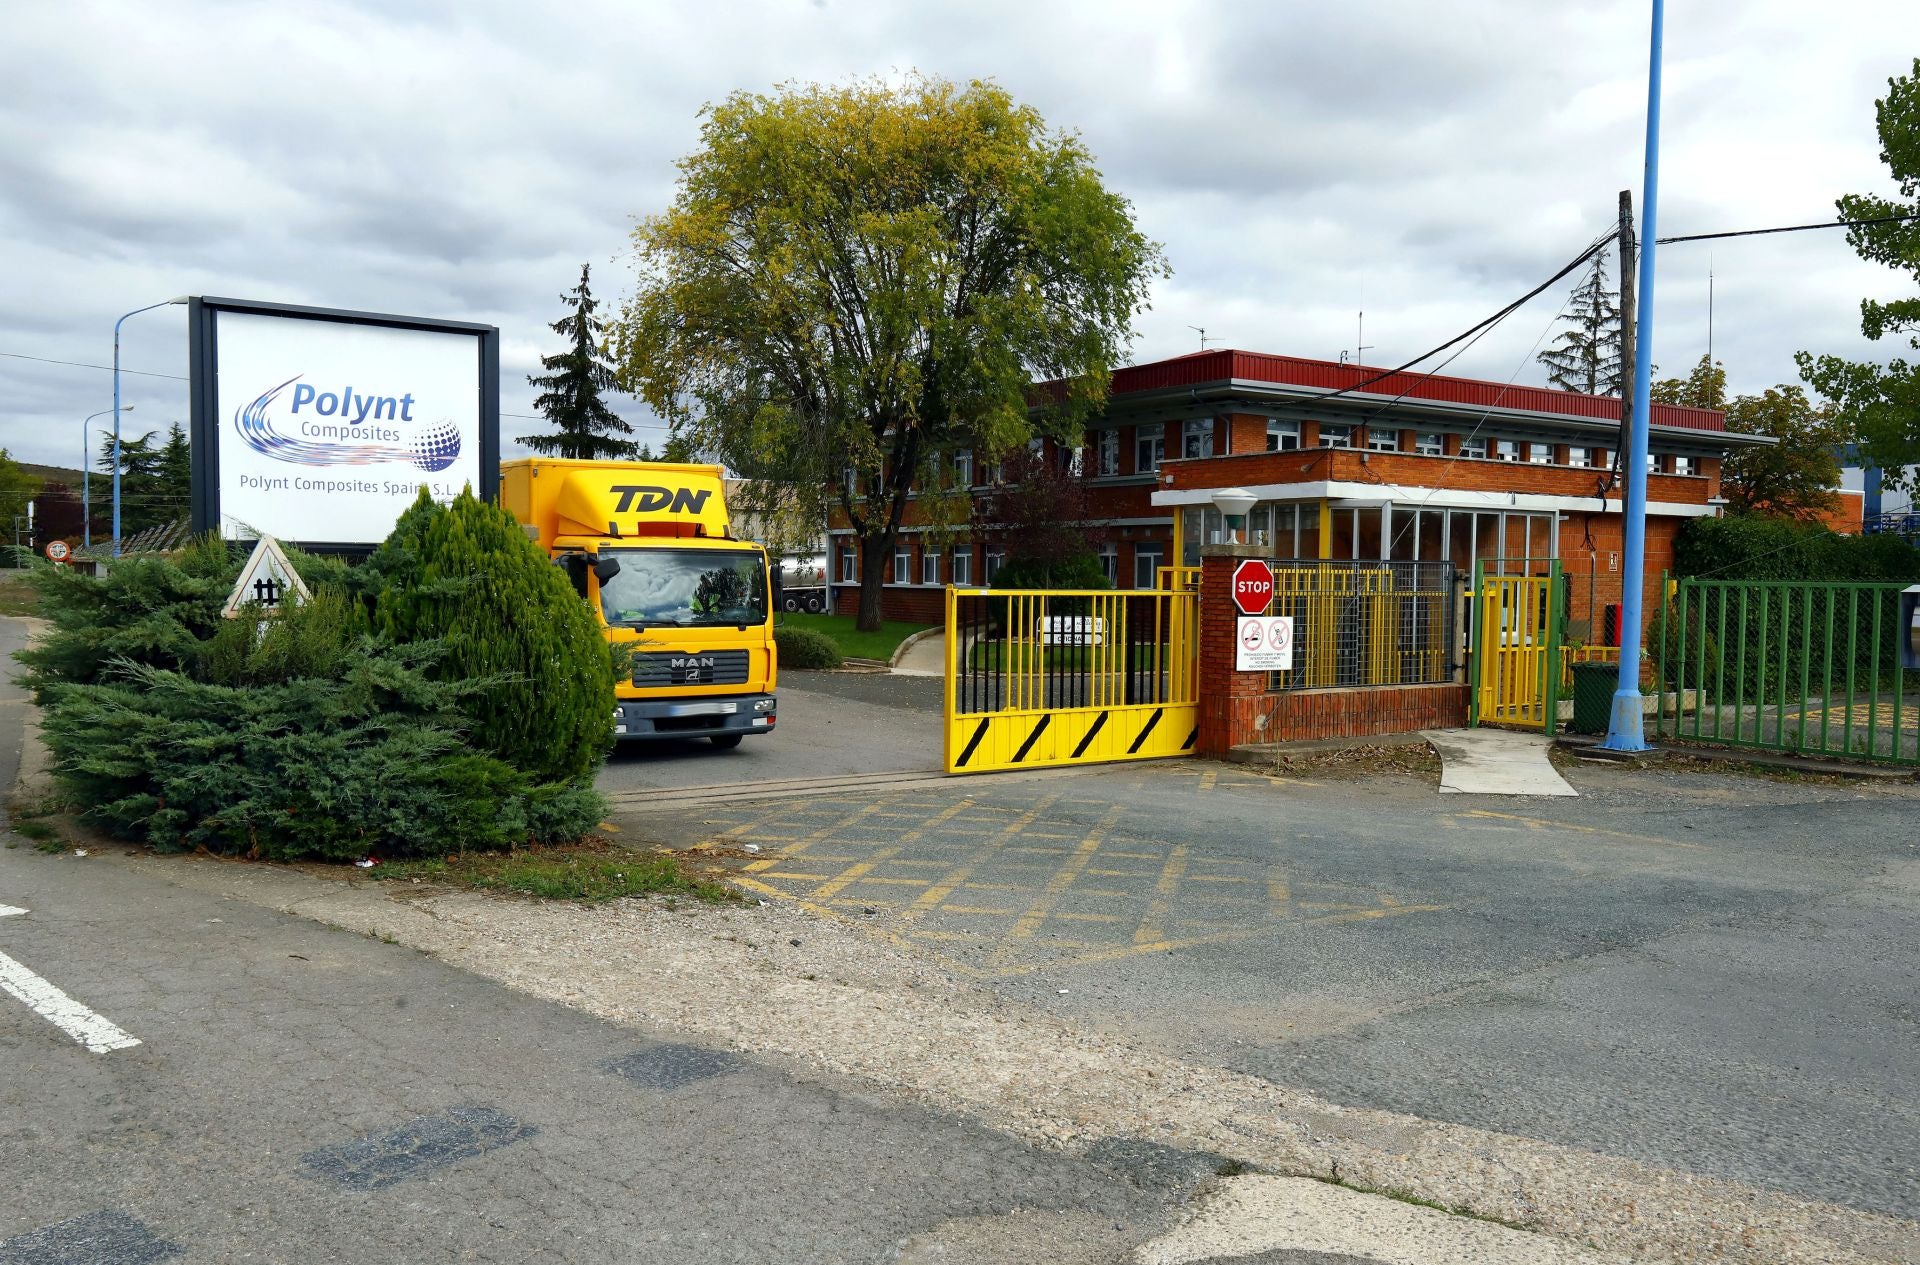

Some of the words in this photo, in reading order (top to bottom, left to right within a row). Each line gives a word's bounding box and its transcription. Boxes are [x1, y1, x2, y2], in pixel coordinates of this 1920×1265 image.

[291, 383, 415, 425] Polynt
[301, 421, 400, 441] Composites
[240, 475, 288, 491] Polynt
[294, 477, 378, 495] Composites
[433, 483, 457, 496] S.L.
[609, 485, 712, 514] TDN
[1238, 581, 1270, 593] STOP
[671, 658, 714, 668] MAN
